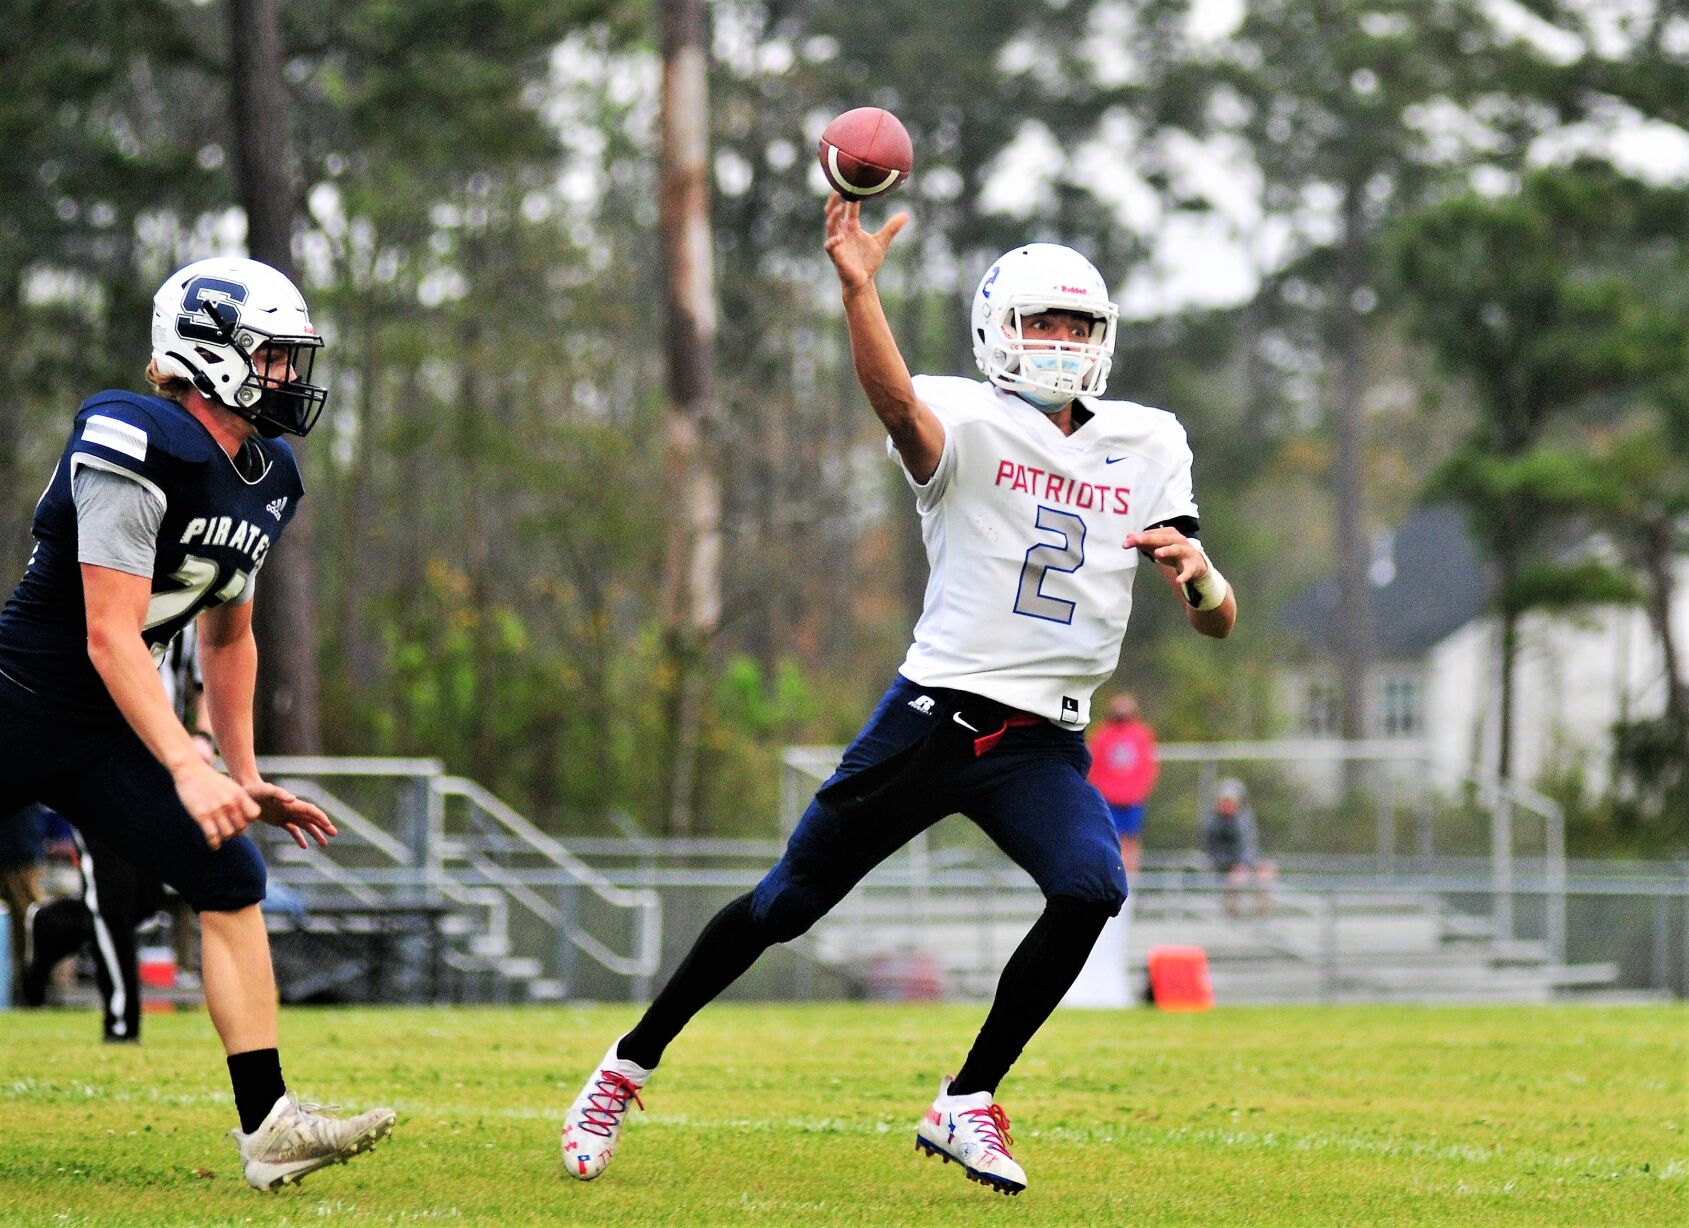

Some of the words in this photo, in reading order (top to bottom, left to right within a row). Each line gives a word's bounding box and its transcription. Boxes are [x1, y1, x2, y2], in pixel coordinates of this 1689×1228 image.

[983, 266, 1000, 299] 2
[175, 275, 249, 348] S
[995, 459, 1130, 515] PATRIOTS
[180, 516, 270, 563] PIRATE
[1012, 504, 1087, 625] 2
